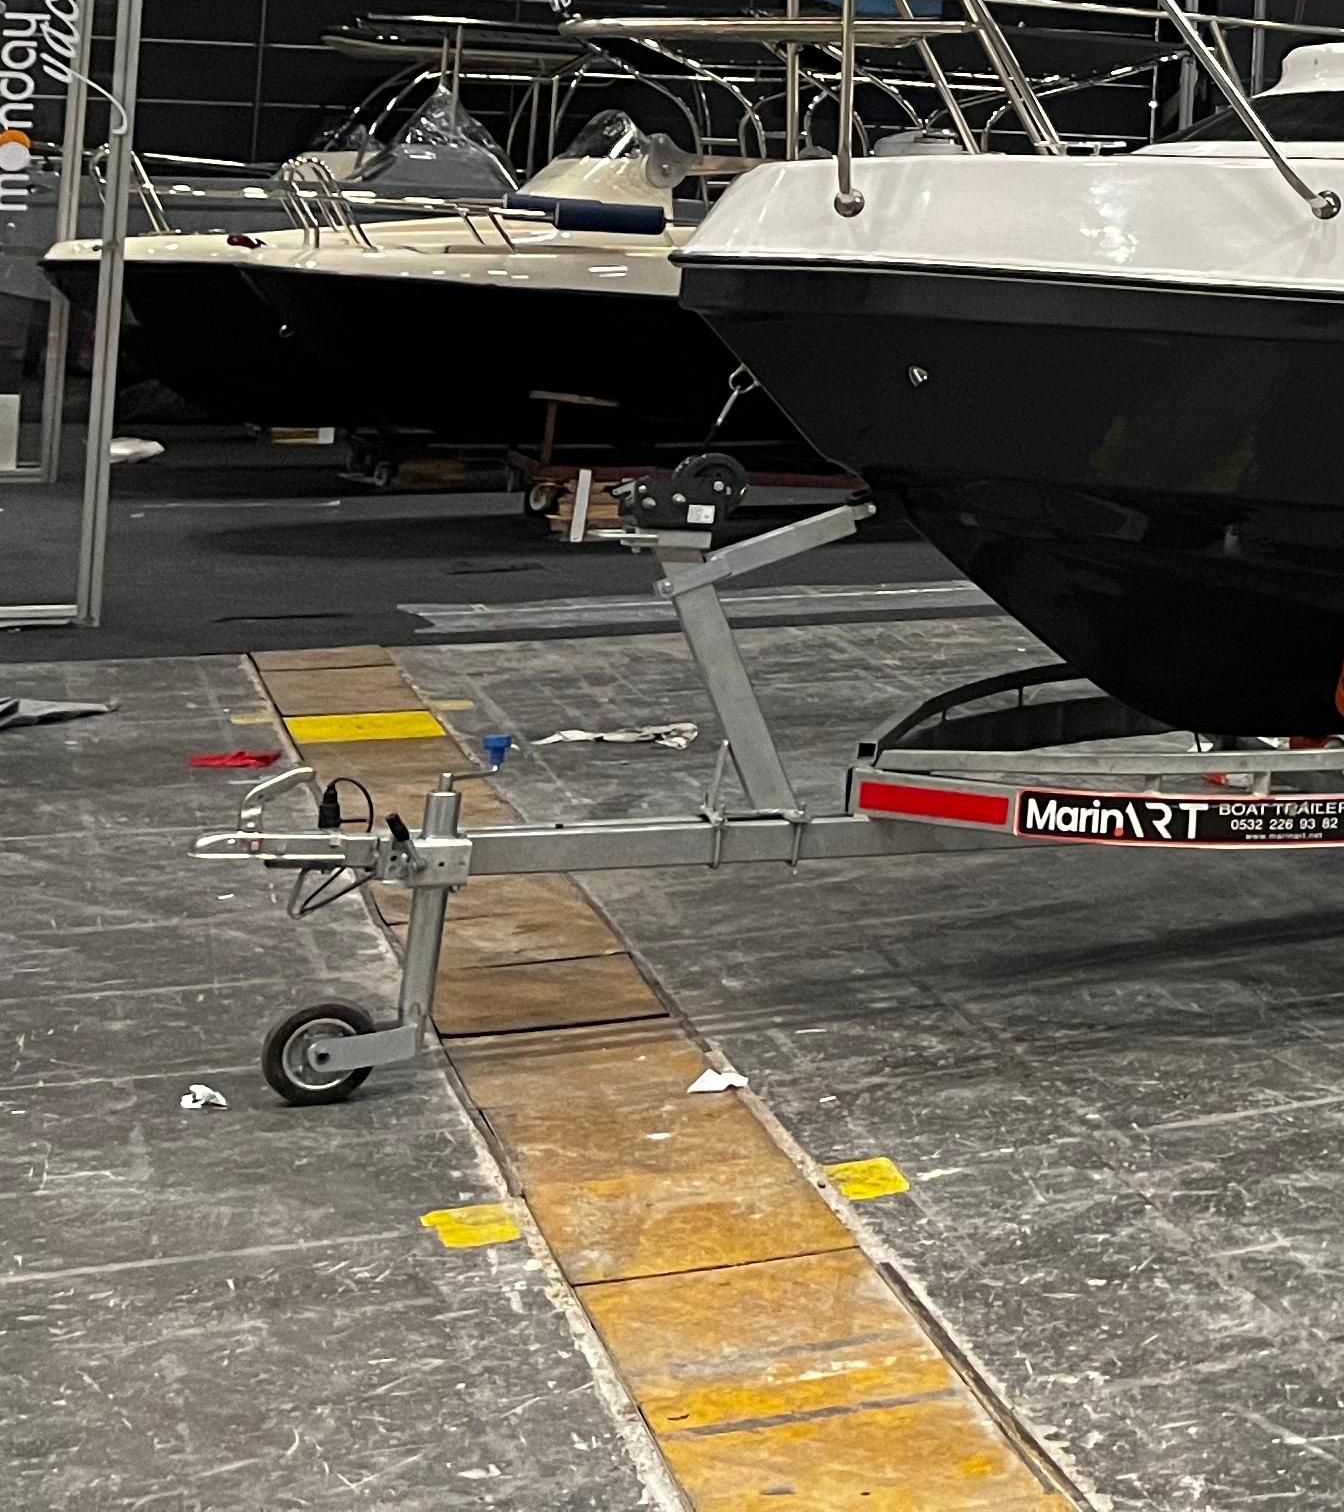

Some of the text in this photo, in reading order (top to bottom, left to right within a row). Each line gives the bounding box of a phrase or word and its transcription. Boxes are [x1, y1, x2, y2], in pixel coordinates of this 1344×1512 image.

[1218, 803, 1268, 817] BOAT
[1230, 817, 1338, 830] 0532 226 93 82
